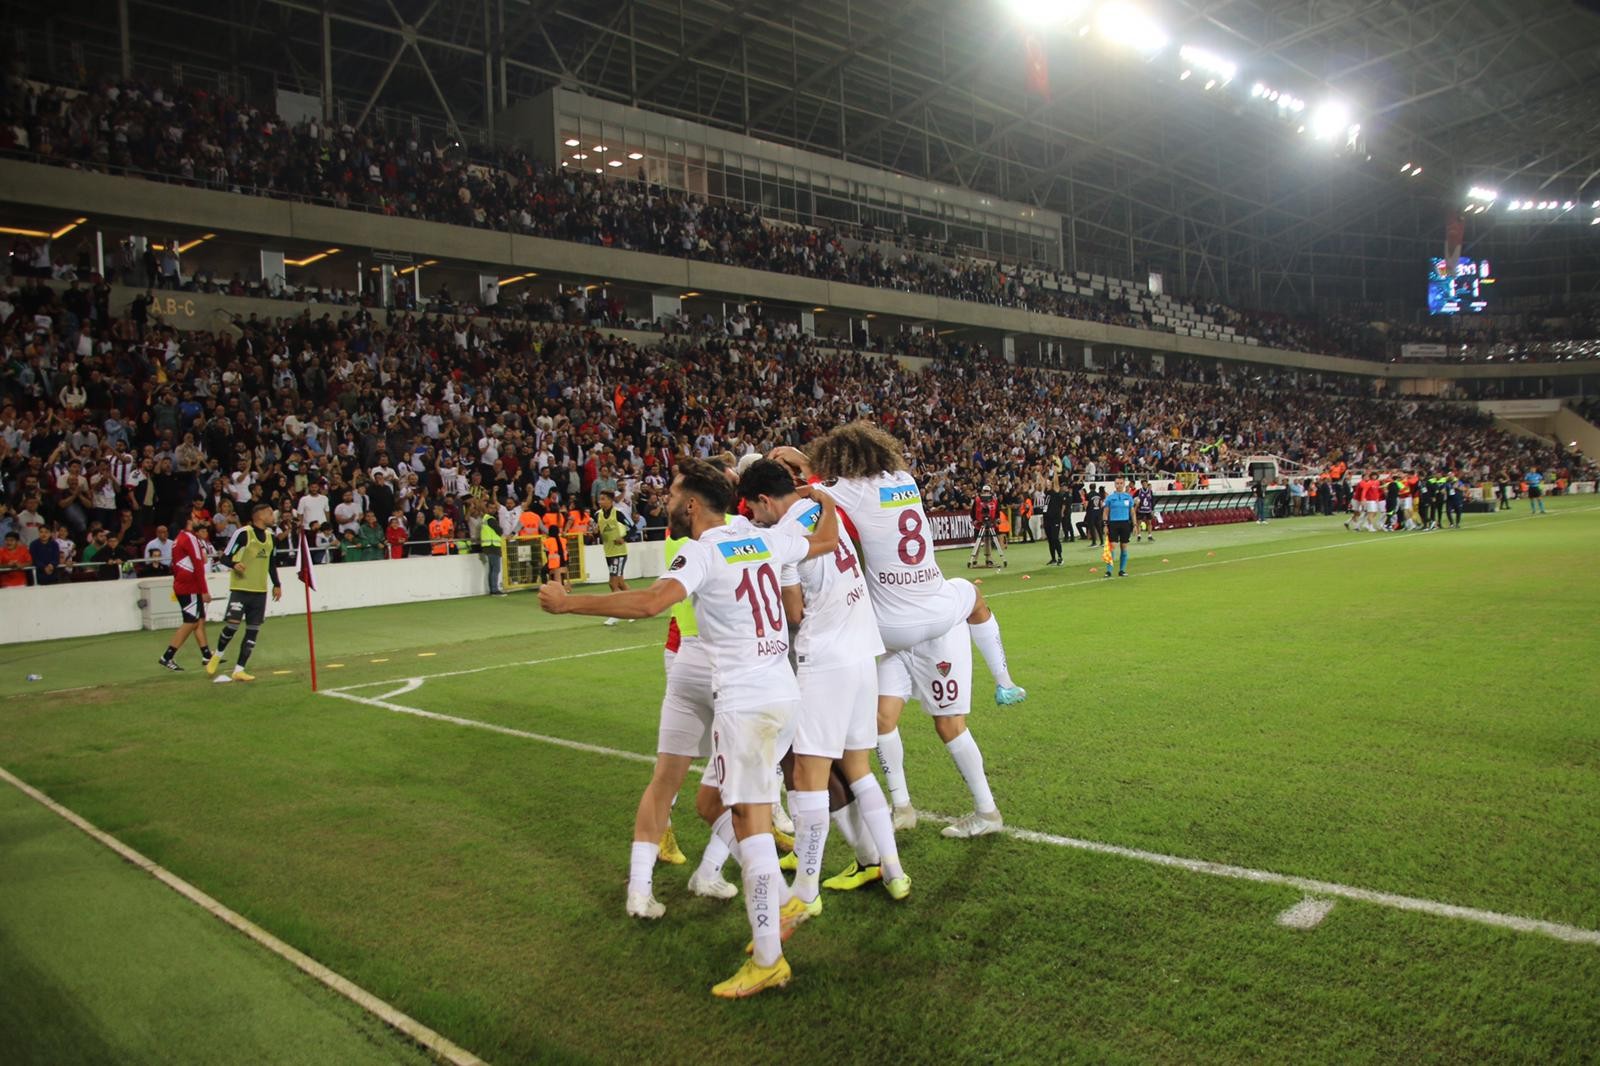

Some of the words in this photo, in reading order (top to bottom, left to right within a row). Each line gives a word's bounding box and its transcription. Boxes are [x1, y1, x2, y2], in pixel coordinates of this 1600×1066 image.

[834, 536, 860, 579] 4
[897, 508, 926, 566] 8
[735, 562, 783, 637] 10
[931, 679, 959, 701] 99
[805, 822, 823, 865] bitexen
